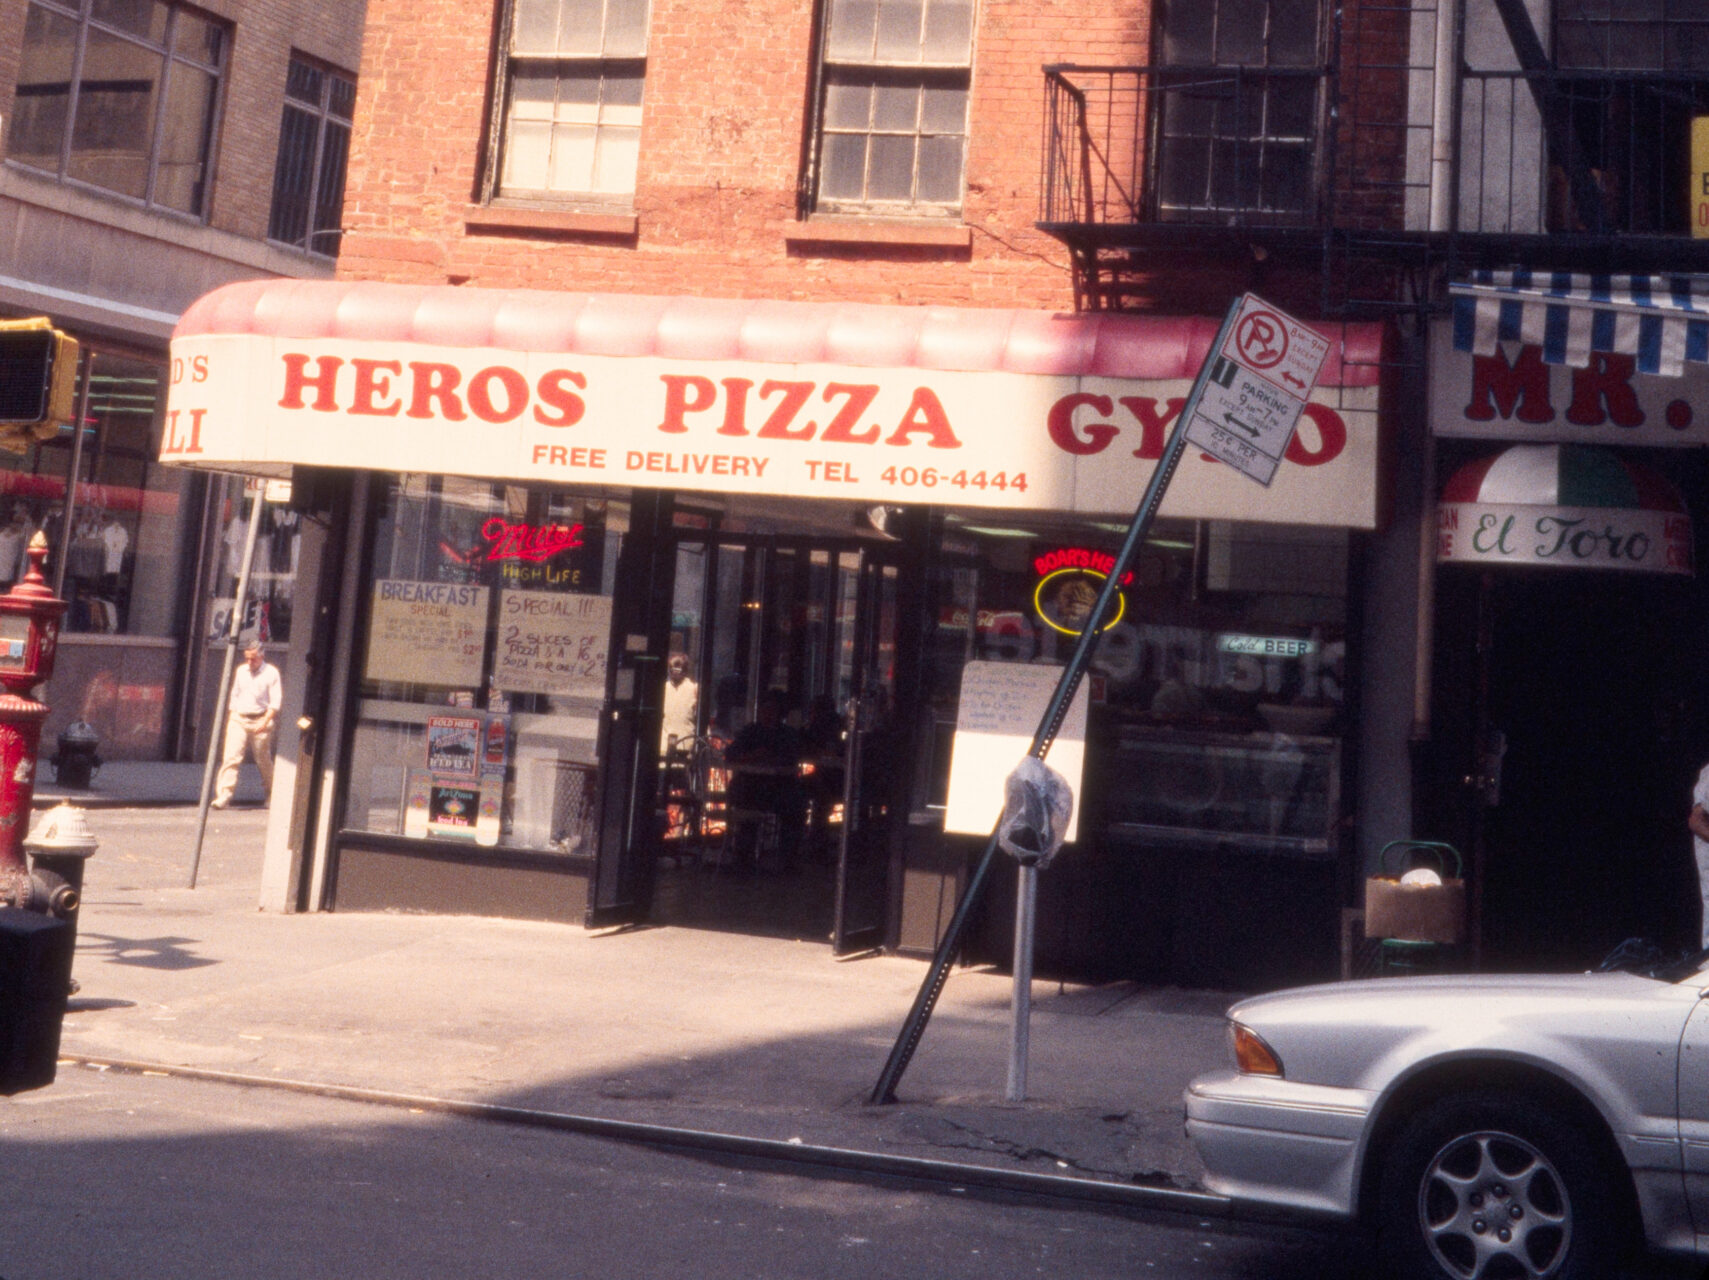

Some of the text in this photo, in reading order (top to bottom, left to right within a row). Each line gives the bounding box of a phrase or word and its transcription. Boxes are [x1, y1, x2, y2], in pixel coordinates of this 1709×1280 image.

[278, 353, 1348, 467] HEROS PIZZA GYO
[1241, 381, 1289, 416] PARKING
[160, 409, 207, 454] LI
[532, 444, 1028, 493] FREE DELIVERY TEL 406-4444
[482, 518, 584, 561] Miller
[1472, 514, 1515, 555] El
[1535, 516, 1649, 562] Toro
[503, 564, 580, 584] HIGH LIFE
[381, 581, 480, 606] BREAKFAST
[506, 595, 573, 617] SPECIAL
[410, 604, 451, 617] SPECIAL
[505, 625, 521, 645] 2
[526, 633, 572, 646] SLICES
[1227, 636, 1308, 655] Cold BEER
[509, 644, 540, 658] PIZZA
